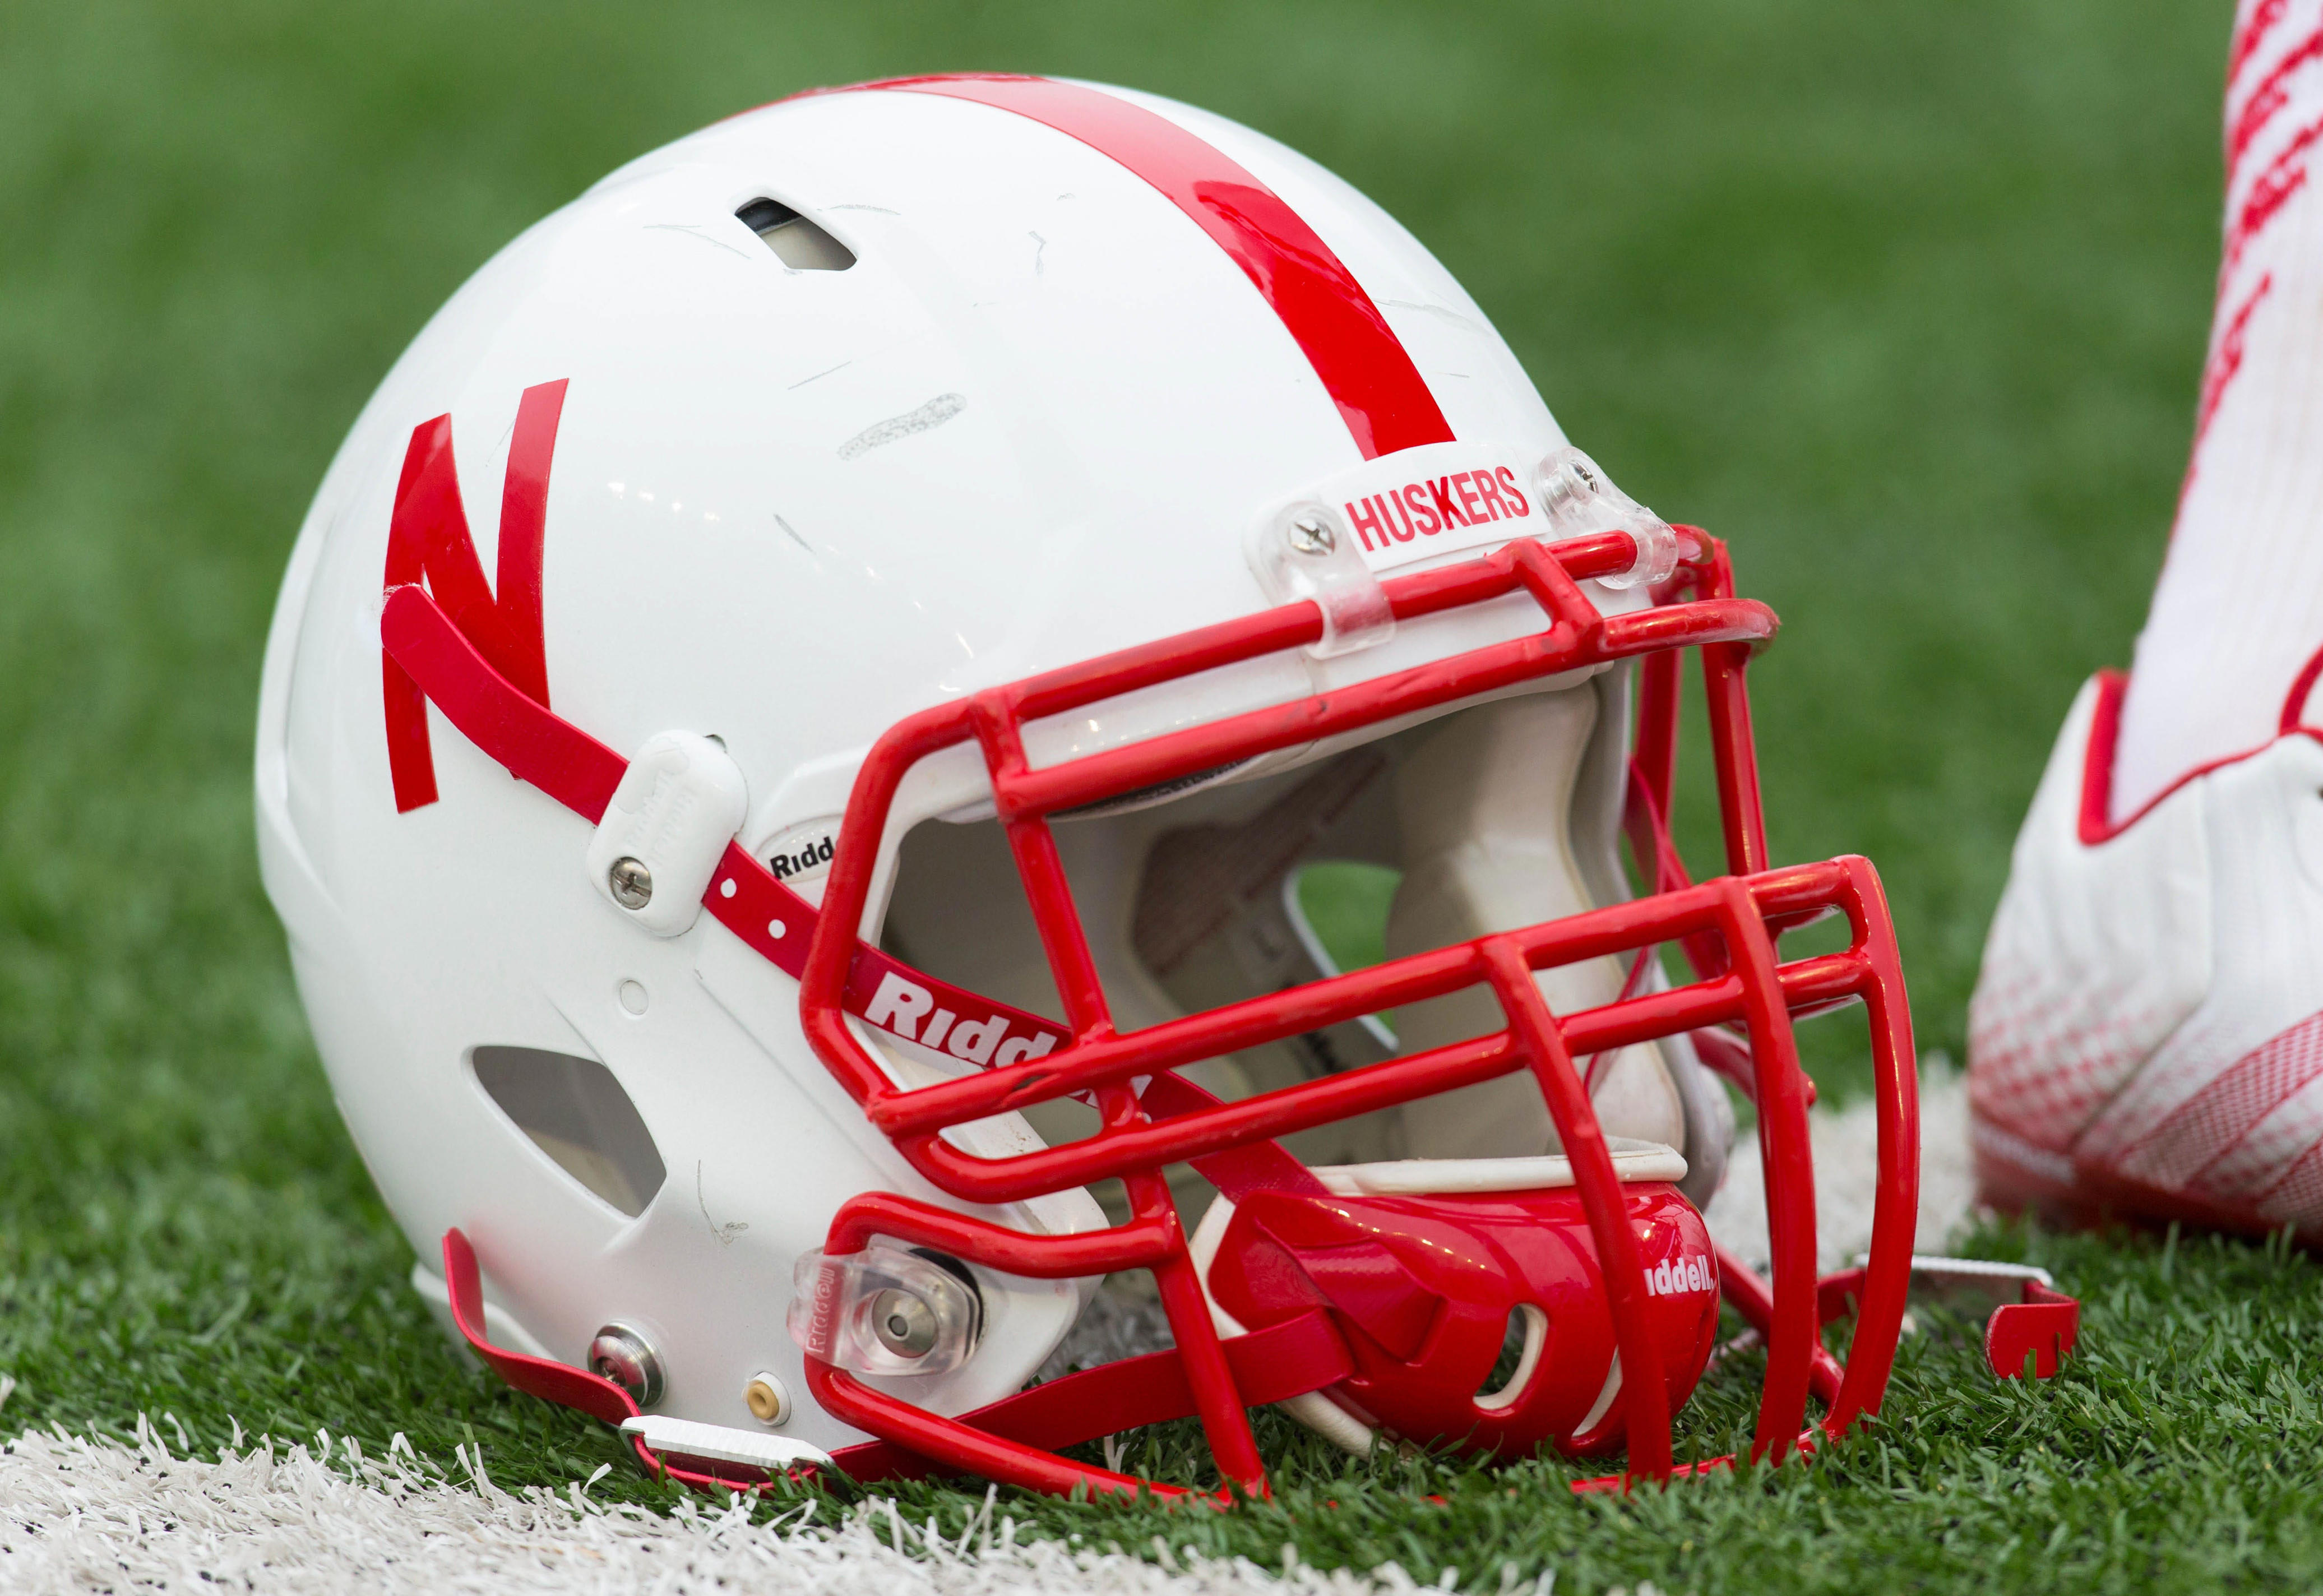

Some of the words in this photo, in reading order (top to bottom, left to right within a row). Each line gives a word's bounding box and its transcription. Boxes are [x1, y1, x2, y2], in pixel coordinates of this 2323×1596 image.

[1345, 466, 1530, 552] HUSKERS
[382, 378, 570, 814] N
[770, 836, 835, 880] Ridd
[1642, 1255, 1711, 1297] iddell
